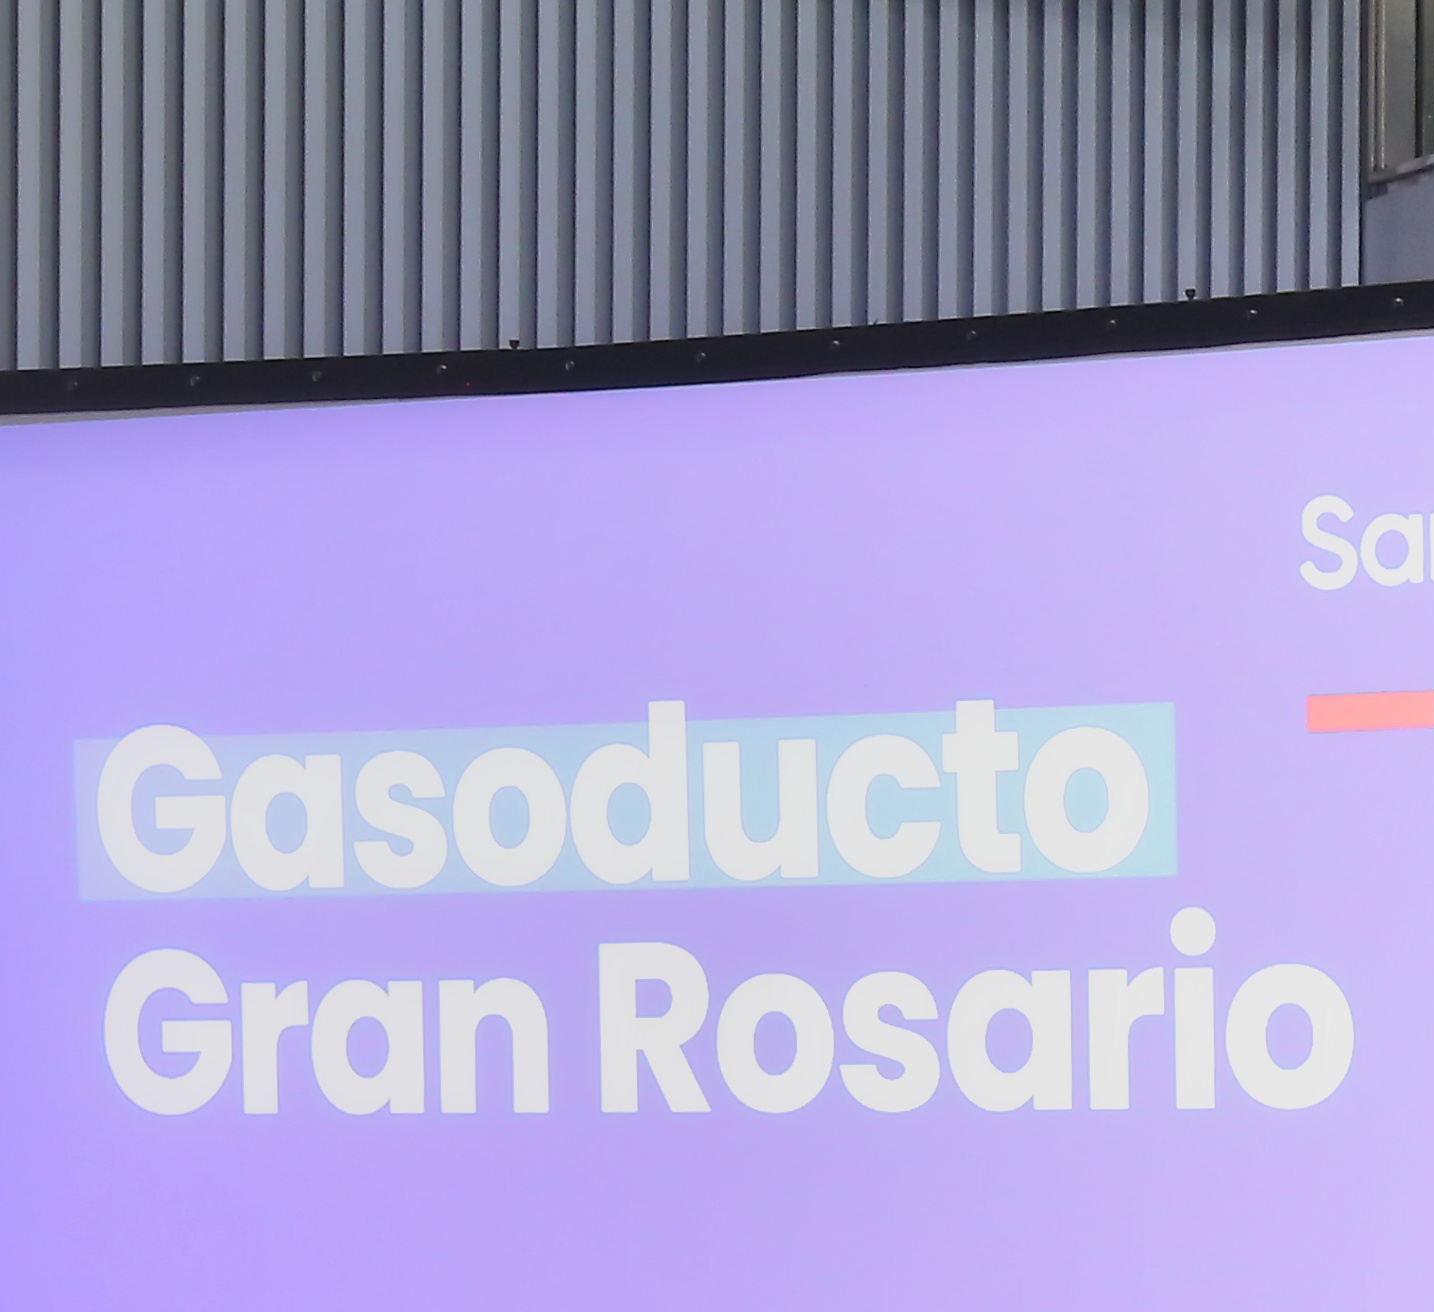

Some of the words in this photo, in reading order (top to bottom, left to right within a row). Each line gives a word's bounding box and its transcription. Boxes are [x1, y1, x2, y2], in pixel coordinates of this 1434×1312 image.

[96, 698, 1151, 894] Gasoducto
[103, 948, 550, 1116] Gran
[598, 906, 1356, 1114] Rosario
